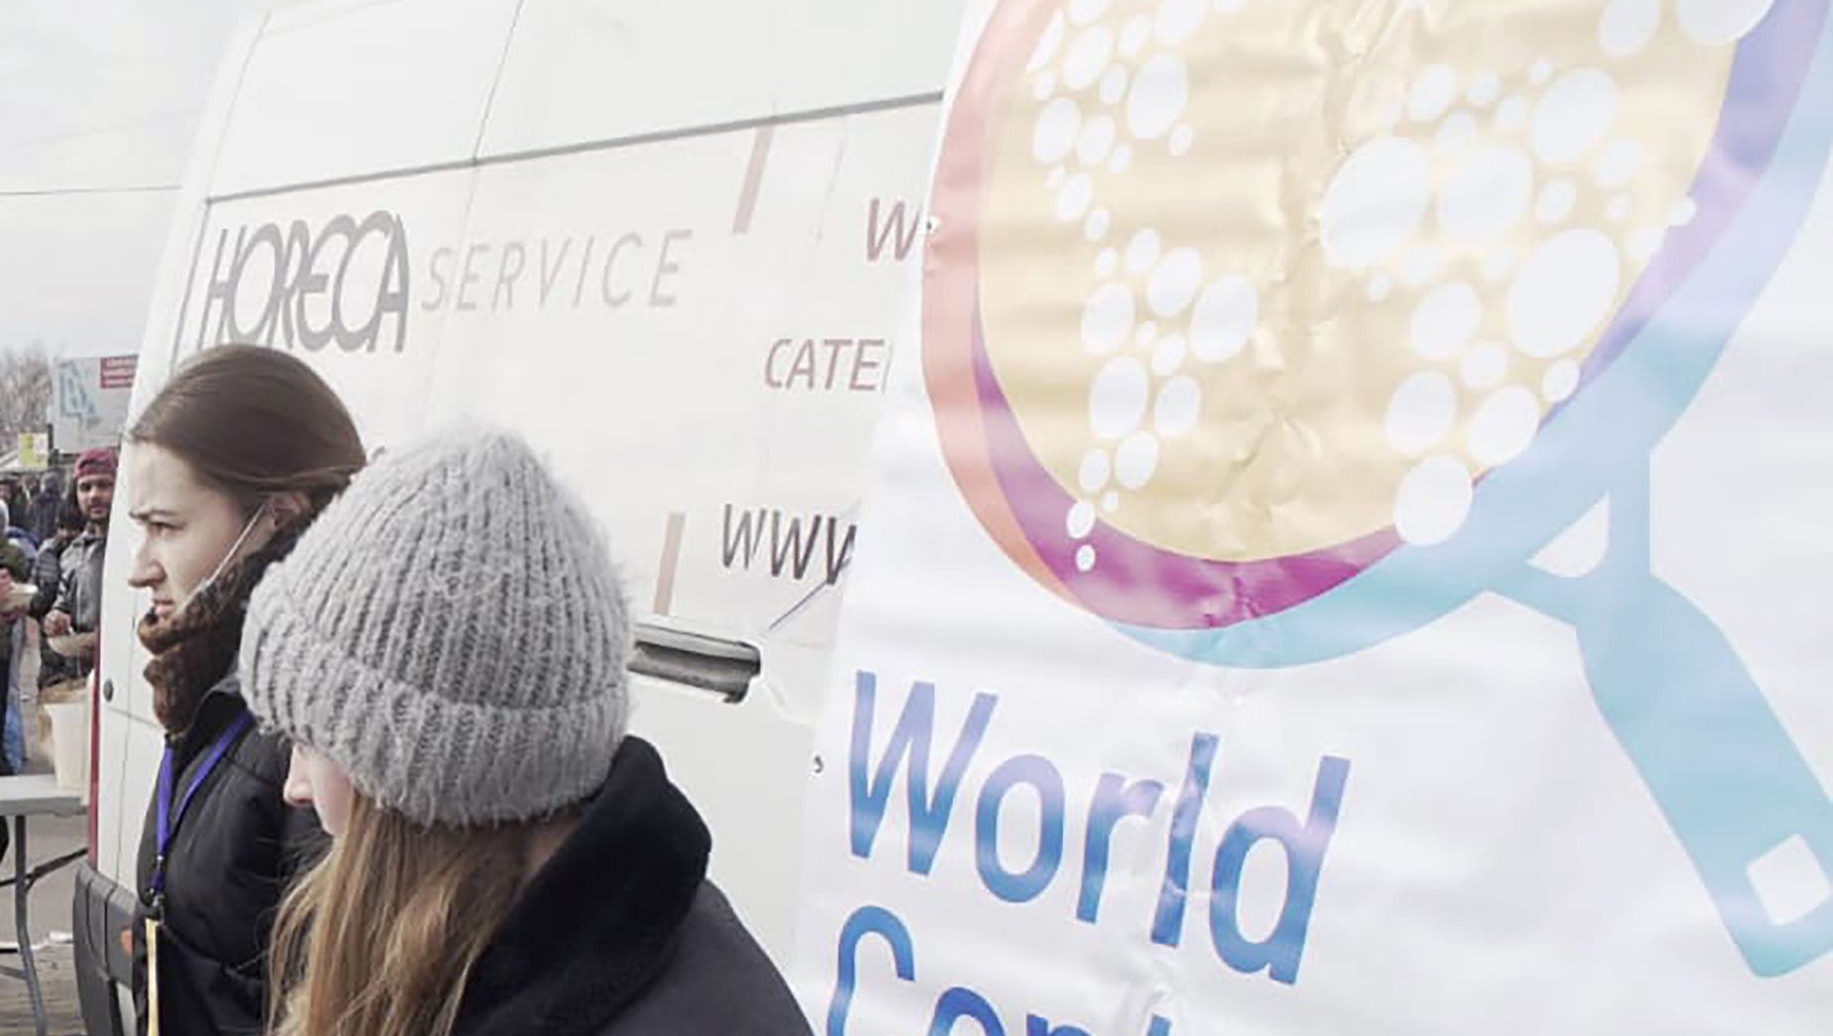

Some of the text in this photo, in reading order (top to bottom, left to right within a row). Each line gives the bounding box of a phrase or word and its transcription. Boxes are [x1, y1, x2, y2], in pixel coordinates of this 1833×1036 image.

[197, 210, 693, 353] HORECA SERVICE
[765, 338, 893, 393] CATE
[849, 670, 1351, 985] World
